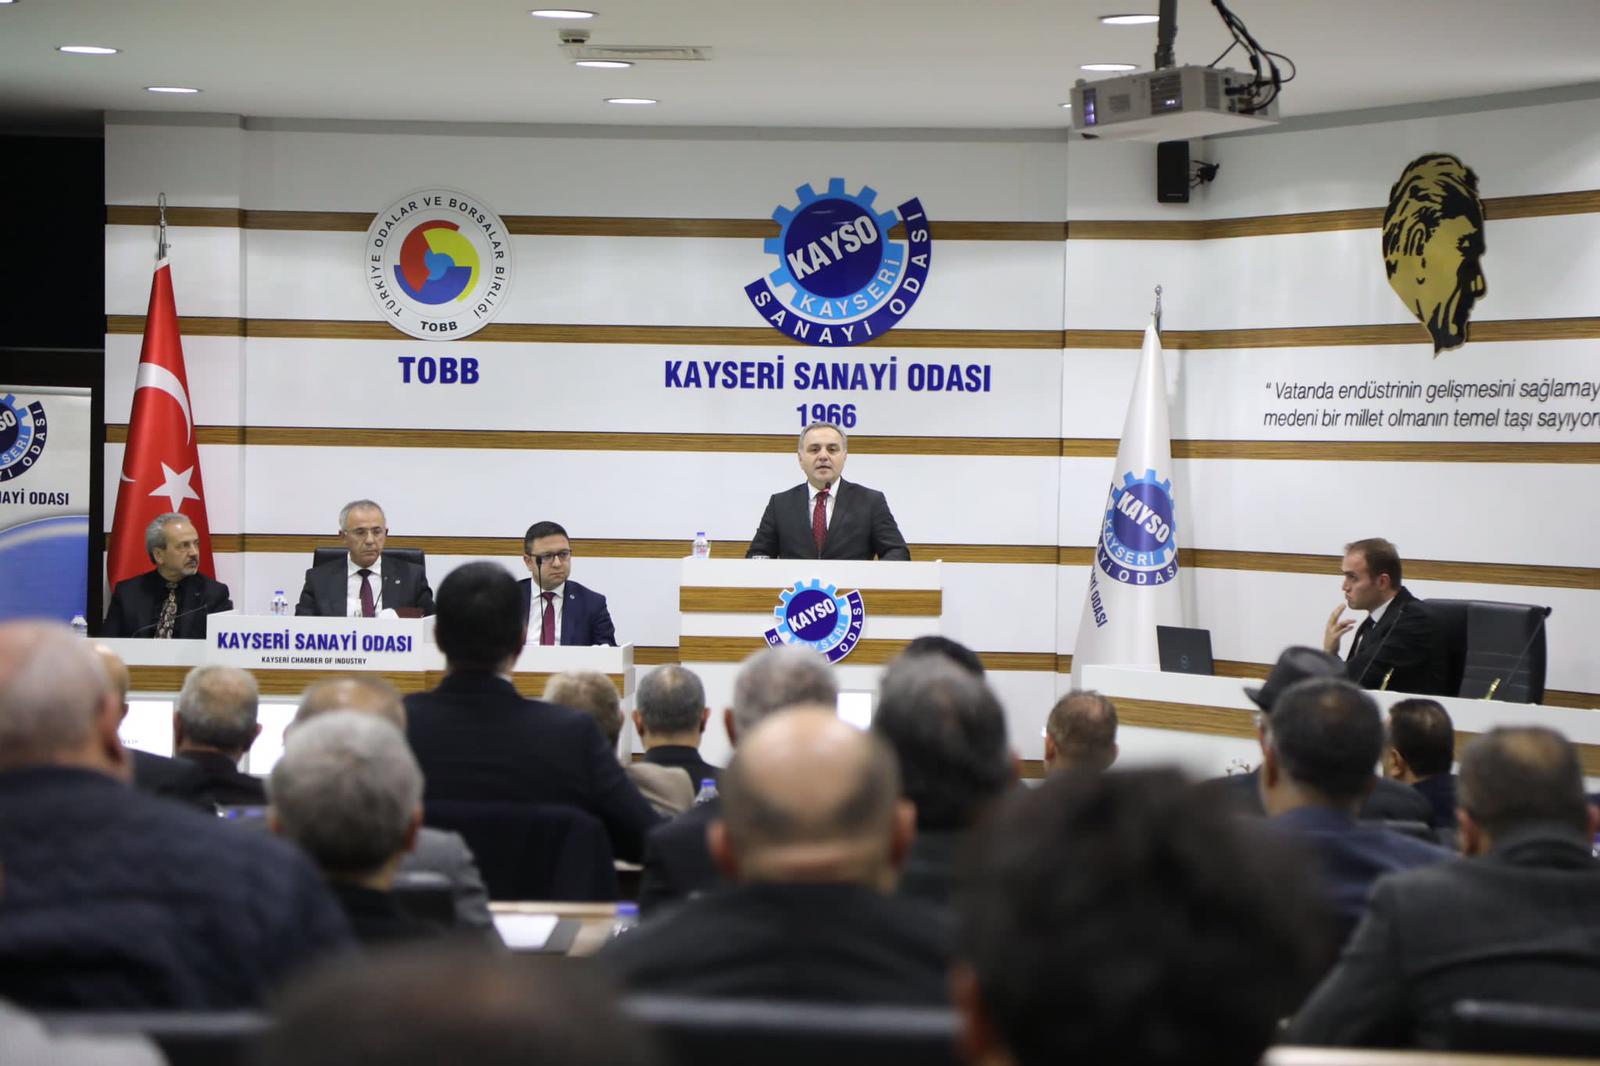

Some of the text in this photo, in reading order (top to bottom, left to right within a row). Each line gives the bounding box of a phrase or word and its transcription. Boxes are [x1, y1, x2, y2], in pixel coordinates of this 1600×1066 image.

[374, 201, 418, 248] ODALAR
[424, 197, 442, 206] VE
[449, 198, 505, 260] BORSALAR
[787, 216, 878, 280] KAYSO
[754, 212, 928, 344] SANAYİ ODASI
[800, 258, 900, 317] KAYSERİ
[420, 320, 458, 332] TOBB
[398, 356, 479, 384] TOBB
[664, 355, 991, 392] KAYSERİ SANAYİ ODASI
[1275, 382, 1334, 400] Vatanda
[1338, 380, 1421, 400] endüstrinin
[1426, 379, 1516, 404] gelişmesini
[796, 404, 856, 428] 1966
[1264, 408, 1600, 431] medeni bir millet olmanın temel taşı sayıyor
[22, 409, 46, 466] ODASI
[0, 488, 69, 505] AYİ ODASI
[1117, 491, 1170, 543] KAYSO
[1119, 560, 1178, 584] ODASI
[788, 598, 836, 632] KAYSO
[840, 599, 862, 652] ODASI
[1090, 590, 1108, 628] ODASI
[218, 629, 412, 652] KAYSERİ SANAYİ ODASI
